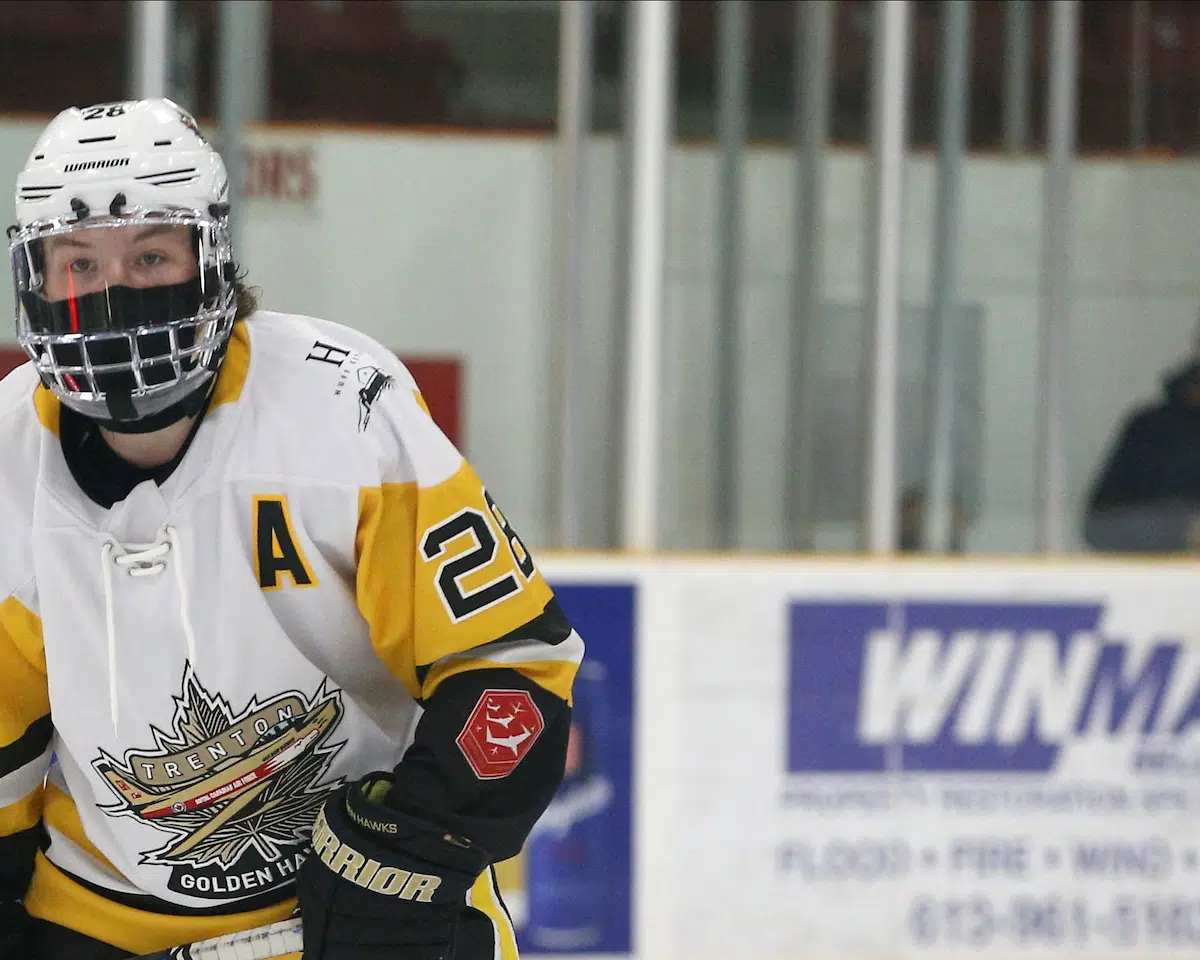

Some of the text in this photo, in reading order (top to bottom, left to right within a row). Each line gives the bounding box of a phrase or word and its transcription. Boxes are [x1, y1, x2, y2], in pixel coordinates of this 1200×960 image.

[82, 105, 125, 120] 28
[64, 158, 130, 172] WARRIOR
[305, 340, 351, 367] H
[254, 496, 317, 590] A
[419, 485, 537, 624] 28
[141, 705, 293, 780] TRENTON
[357, 813, 398, 834] HAWKS
[311, 800, 442, 903] ARRIOR
[180, 867, 273, 893] GOLDEN
